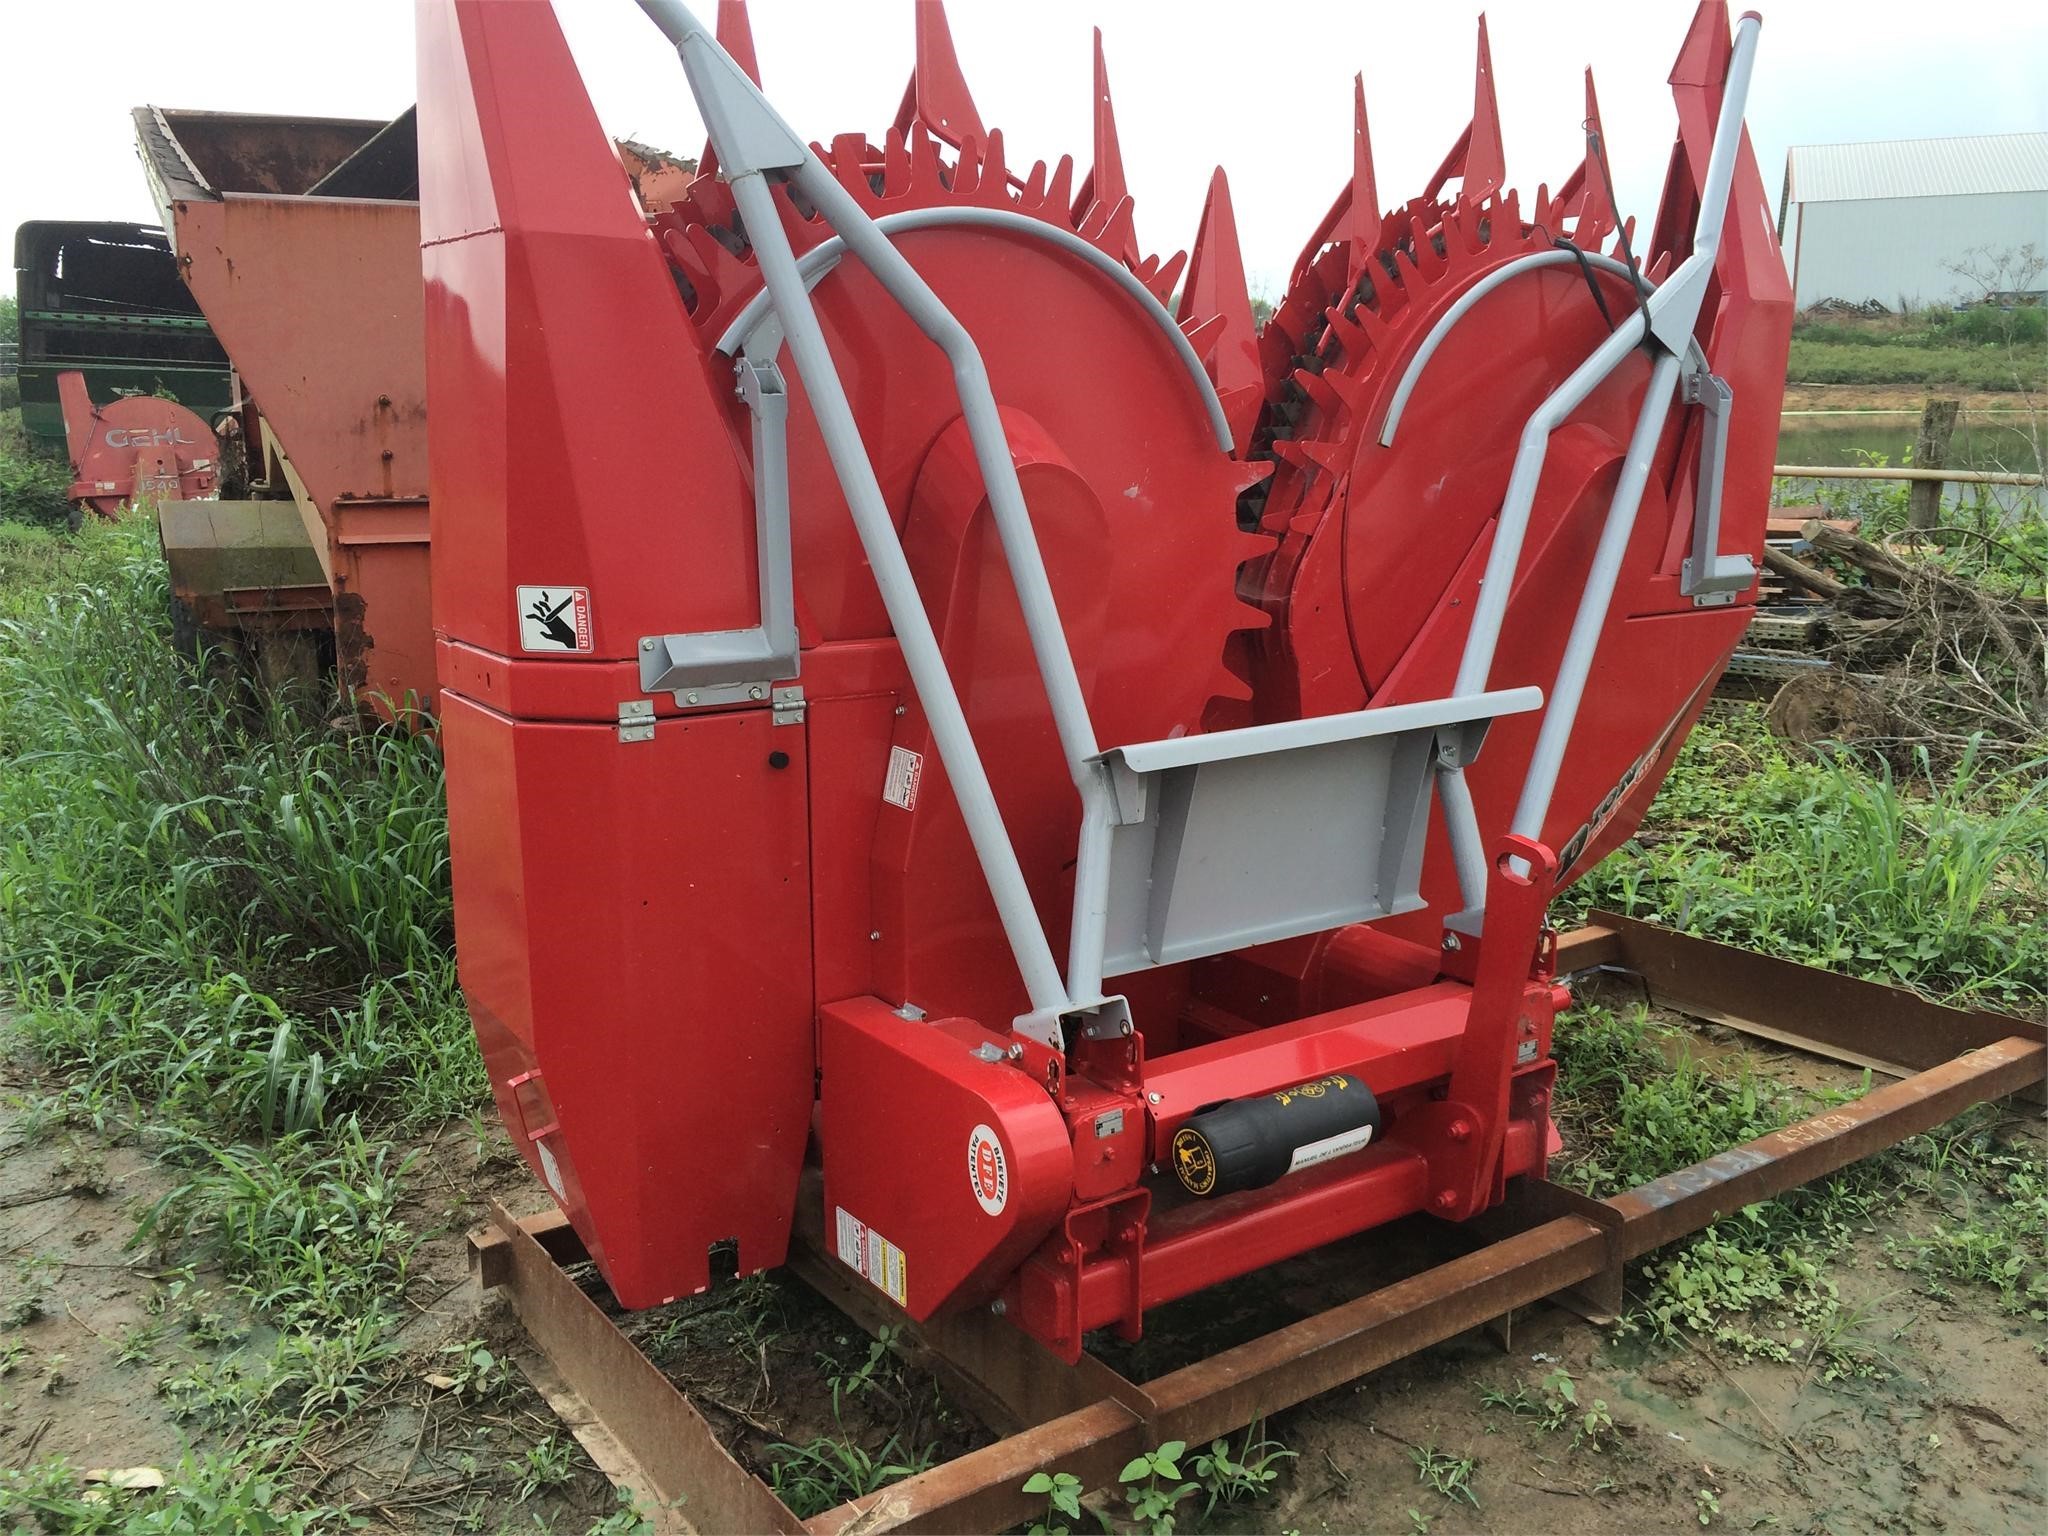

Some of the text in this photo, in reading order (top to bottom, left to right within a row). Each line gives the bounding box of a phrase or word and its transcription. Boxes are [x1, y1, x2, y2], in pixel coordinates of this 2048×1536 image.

[105, 427, 195, 448] GEHL
[576, 605, 589, 648] DANGER
[909, 771, 919, 804] DANGER
[969, 1134, 983, 1199] PATENTED
[982, 1147, 994, 1194] DFE
